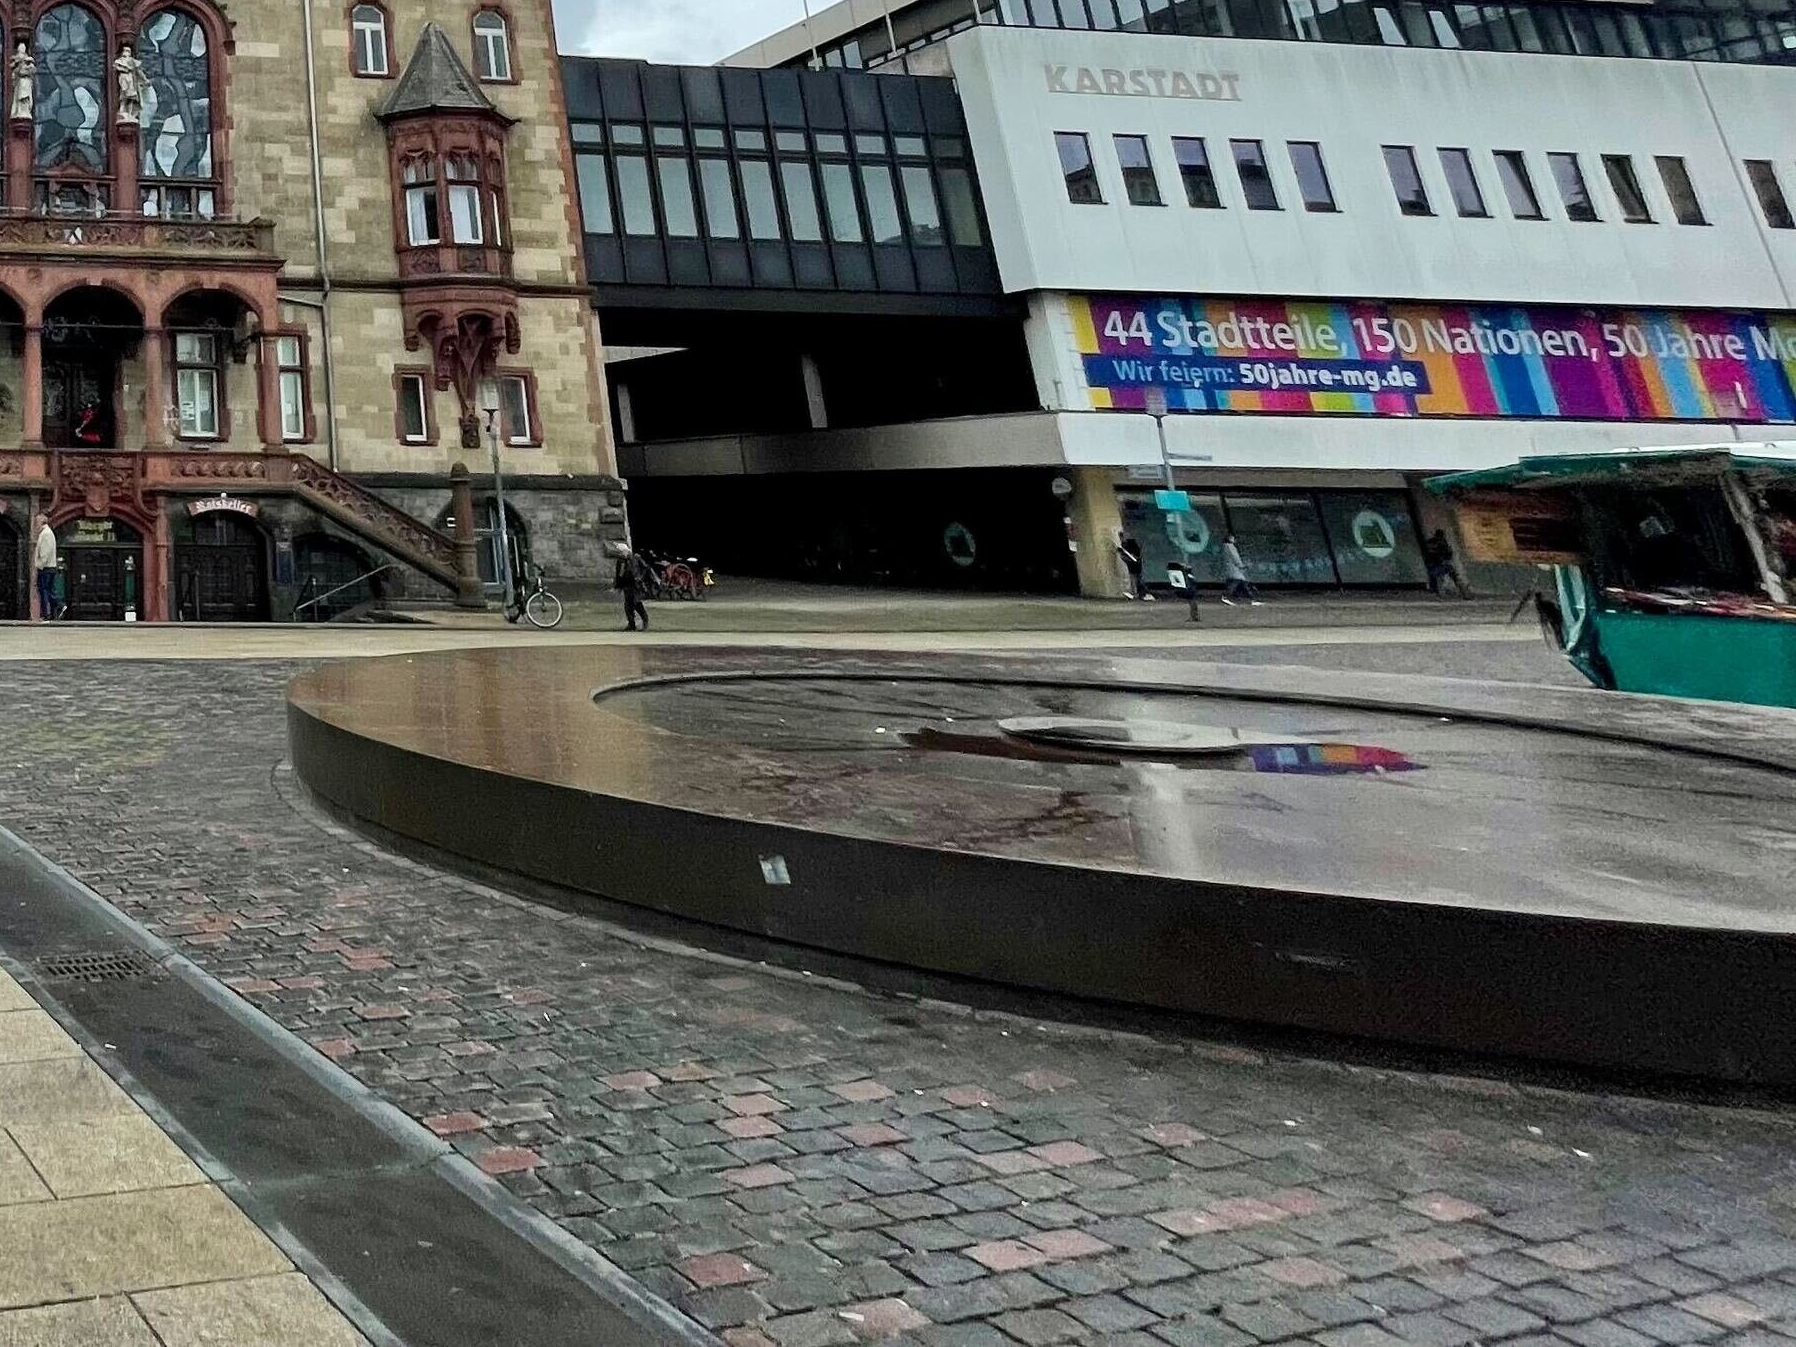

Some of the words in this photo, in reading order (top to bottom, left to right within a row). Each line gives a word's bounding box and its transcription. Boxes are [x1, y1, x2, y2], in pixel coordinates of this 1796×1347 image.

[1044, 63, 1241, 101] KARSTADT
[1104, 311, 1152, 346] 44
[1156, 310, 1348, 356] Stadtteile,
[1353, 317, 1417, 353] 150
[1420, 318, 1598, 362] Nationen,
[1602, 324, 1648, 358] 50
[1652, 324, 1746, 360] Jahre
[1112, 359, 1153, 382] Wir
[1158, 364, 1235, 384] feiern:
[1239, 364, 1417, 391] 50jahre-mg.de
